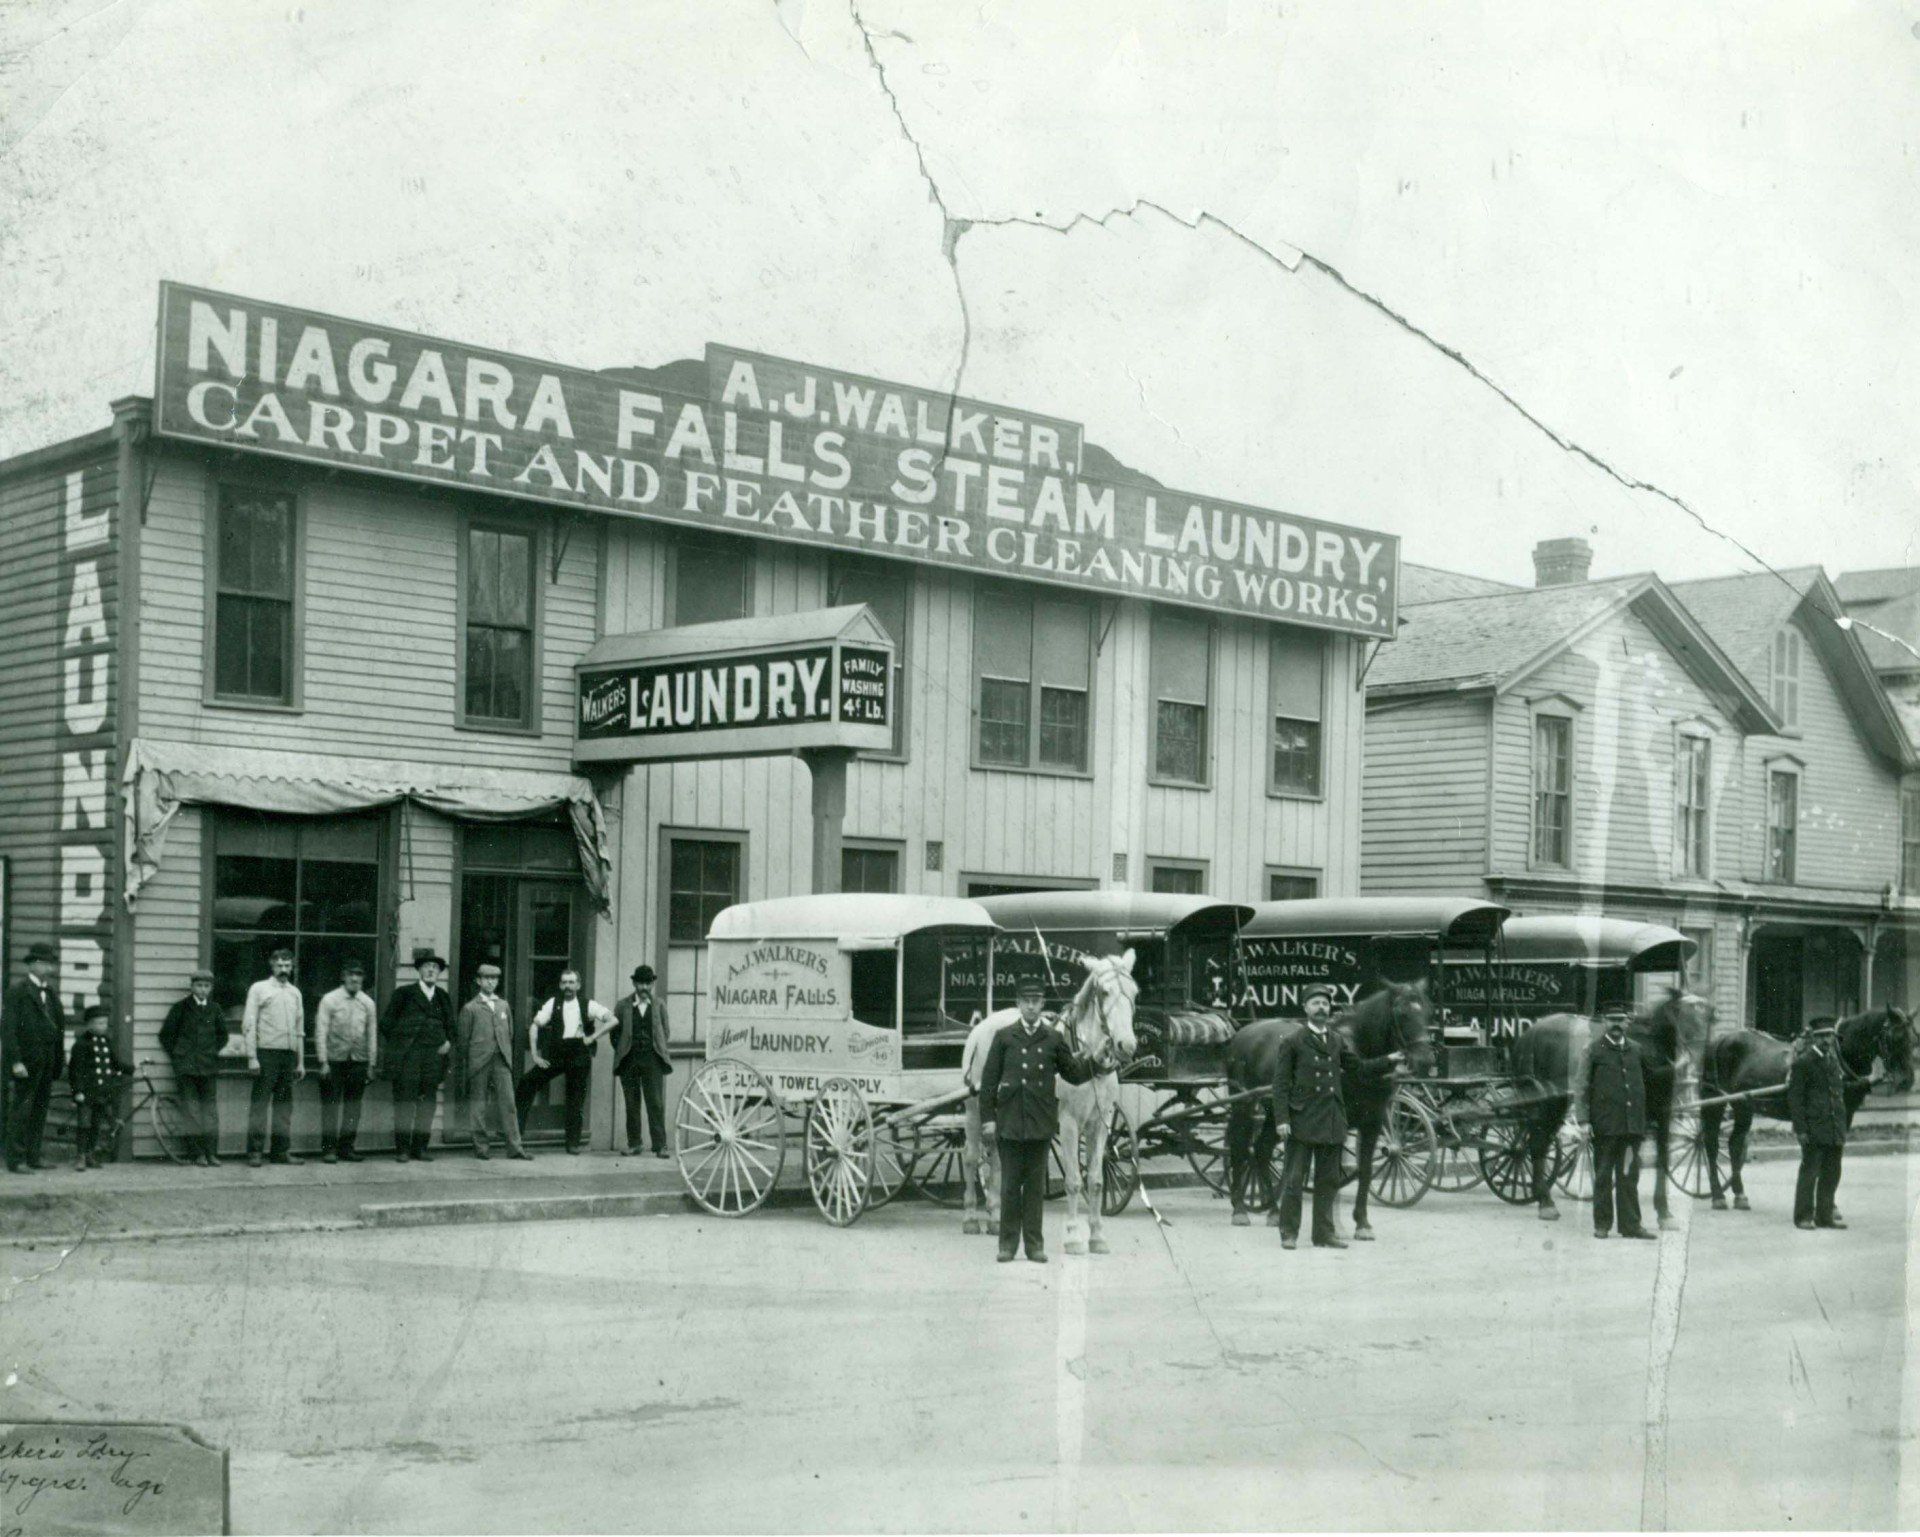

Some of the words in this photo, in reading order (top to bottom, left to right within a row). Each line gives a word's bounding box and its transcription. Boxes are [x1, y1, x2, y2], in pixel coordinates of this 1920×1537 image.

[187, 300, 574, 438] NIAGARA
[616, 389, 851, 490] FALLS
[890, 448, 1114, 540] STEAM
[1145, 496, 1387, 593] LAUNDRY,
[187, 382, 503, 476] CARPET
[514, 443, 660, 503] AND
[683, 470, 973, 557] FEATHER
[986, 528, 1223, 600] CLEANING
[1234, 570, 1387, 627] WORKS.
[844, 659, 884, 676] FAMILY
[842, 679, 884, 697] WASHING
[582, 685, 626, 722] WALKER'S
[1291, 964, 1330, 976] FALLS
[951, 973, 1016, 986] NIAGRA
[715, 985, 778, 1010] NIAGARA
[1211, 977, 1362, 1007] LAUNRY
[1456, 987, 1499, 1000] NIAGAA
[1501, 987, 1537, 1000] FALLS
[779, 1075, 822, 1091] TOWEL
